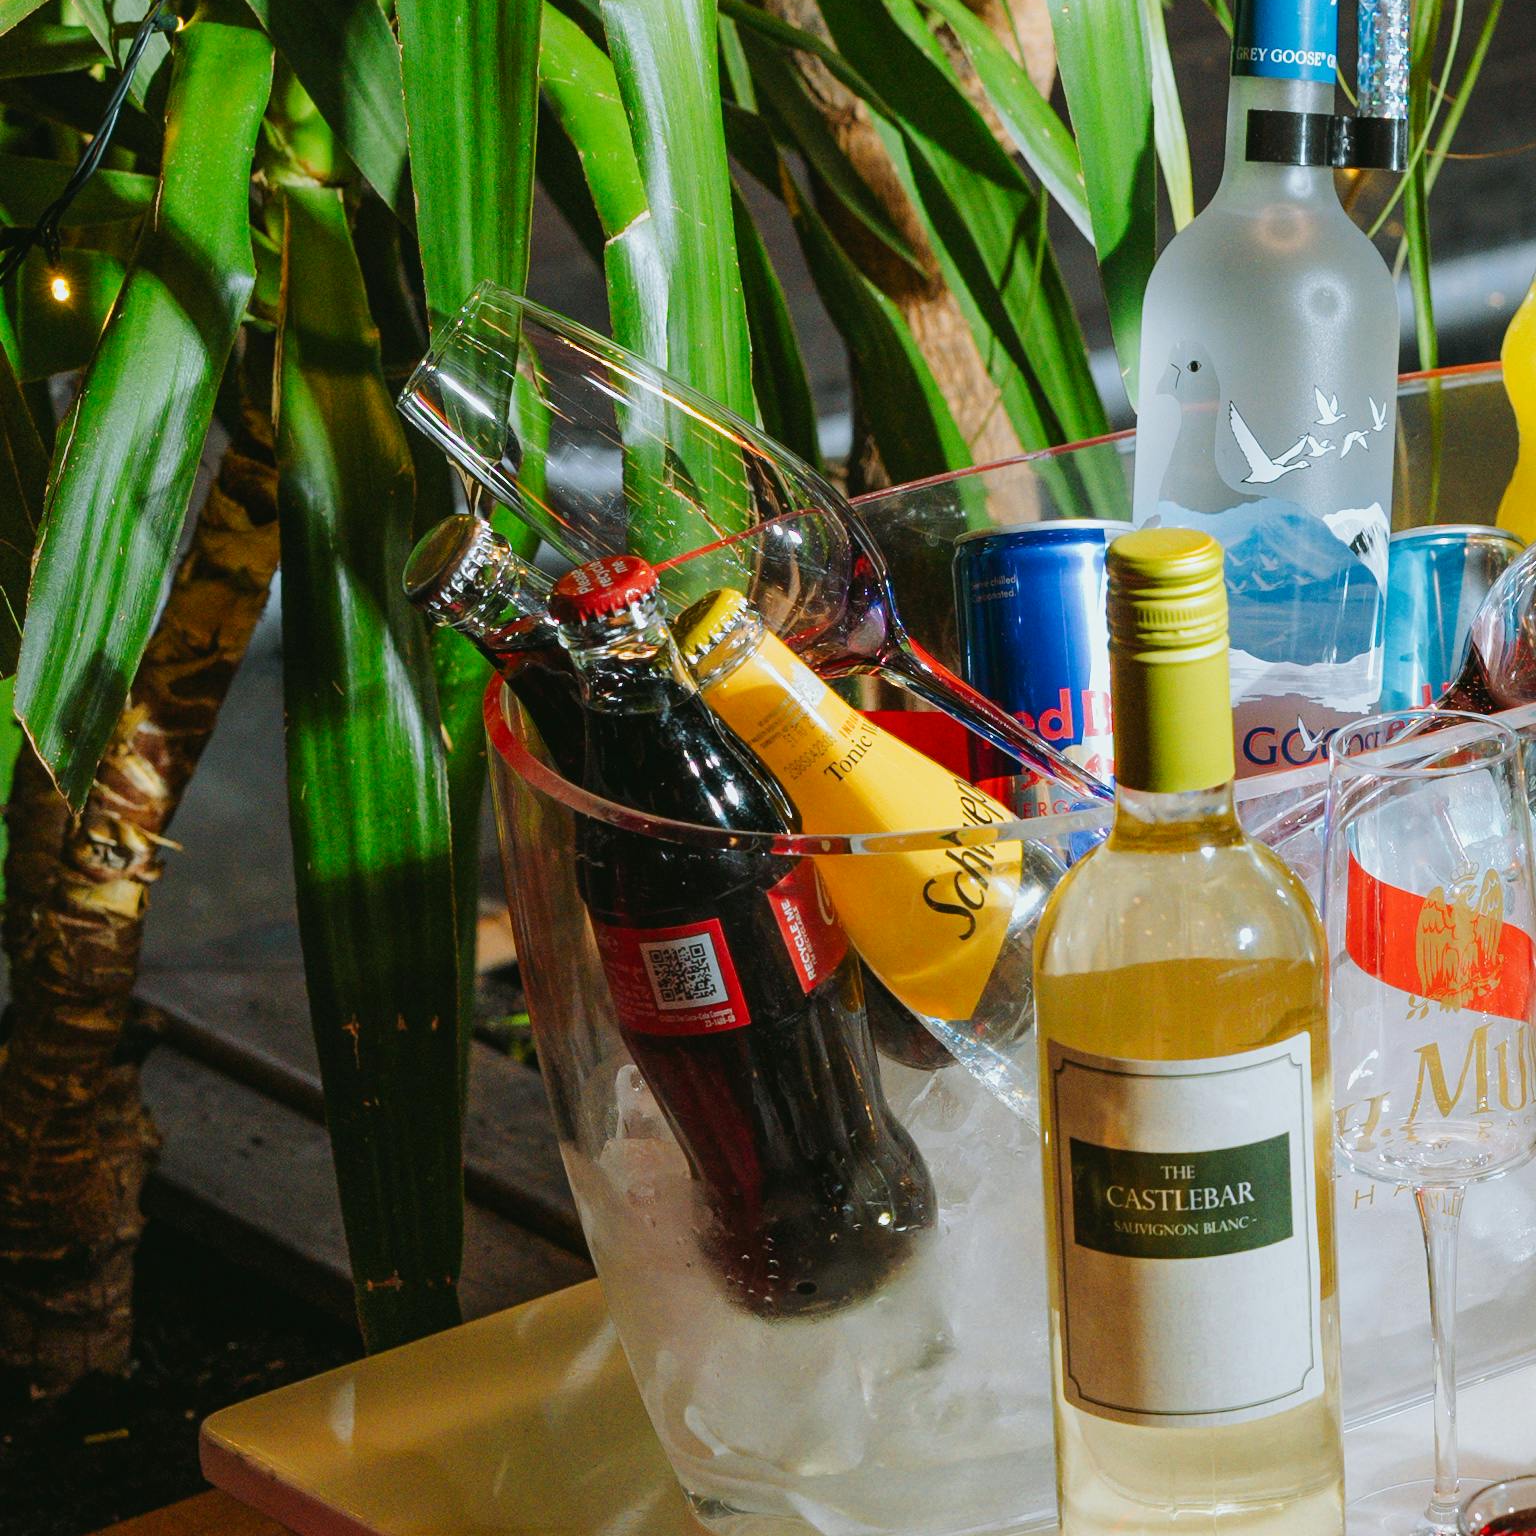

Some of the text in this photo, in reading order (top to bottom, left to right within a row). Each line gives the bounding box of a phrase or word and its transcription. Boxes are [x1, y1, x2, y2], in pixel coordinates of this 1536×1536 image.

[1236, 48, 1267, 62] GREY
[823, 735, 873, 782] Tonic
[780, 898, 817, 981] RECYCLE ME
[1160, 1164, 1196, 1181] THE
[1106, 1181, 1255, 1212] CASTLEBAR
[1113, 1215, 1250, 1237] SAUVIGNON BLANC
